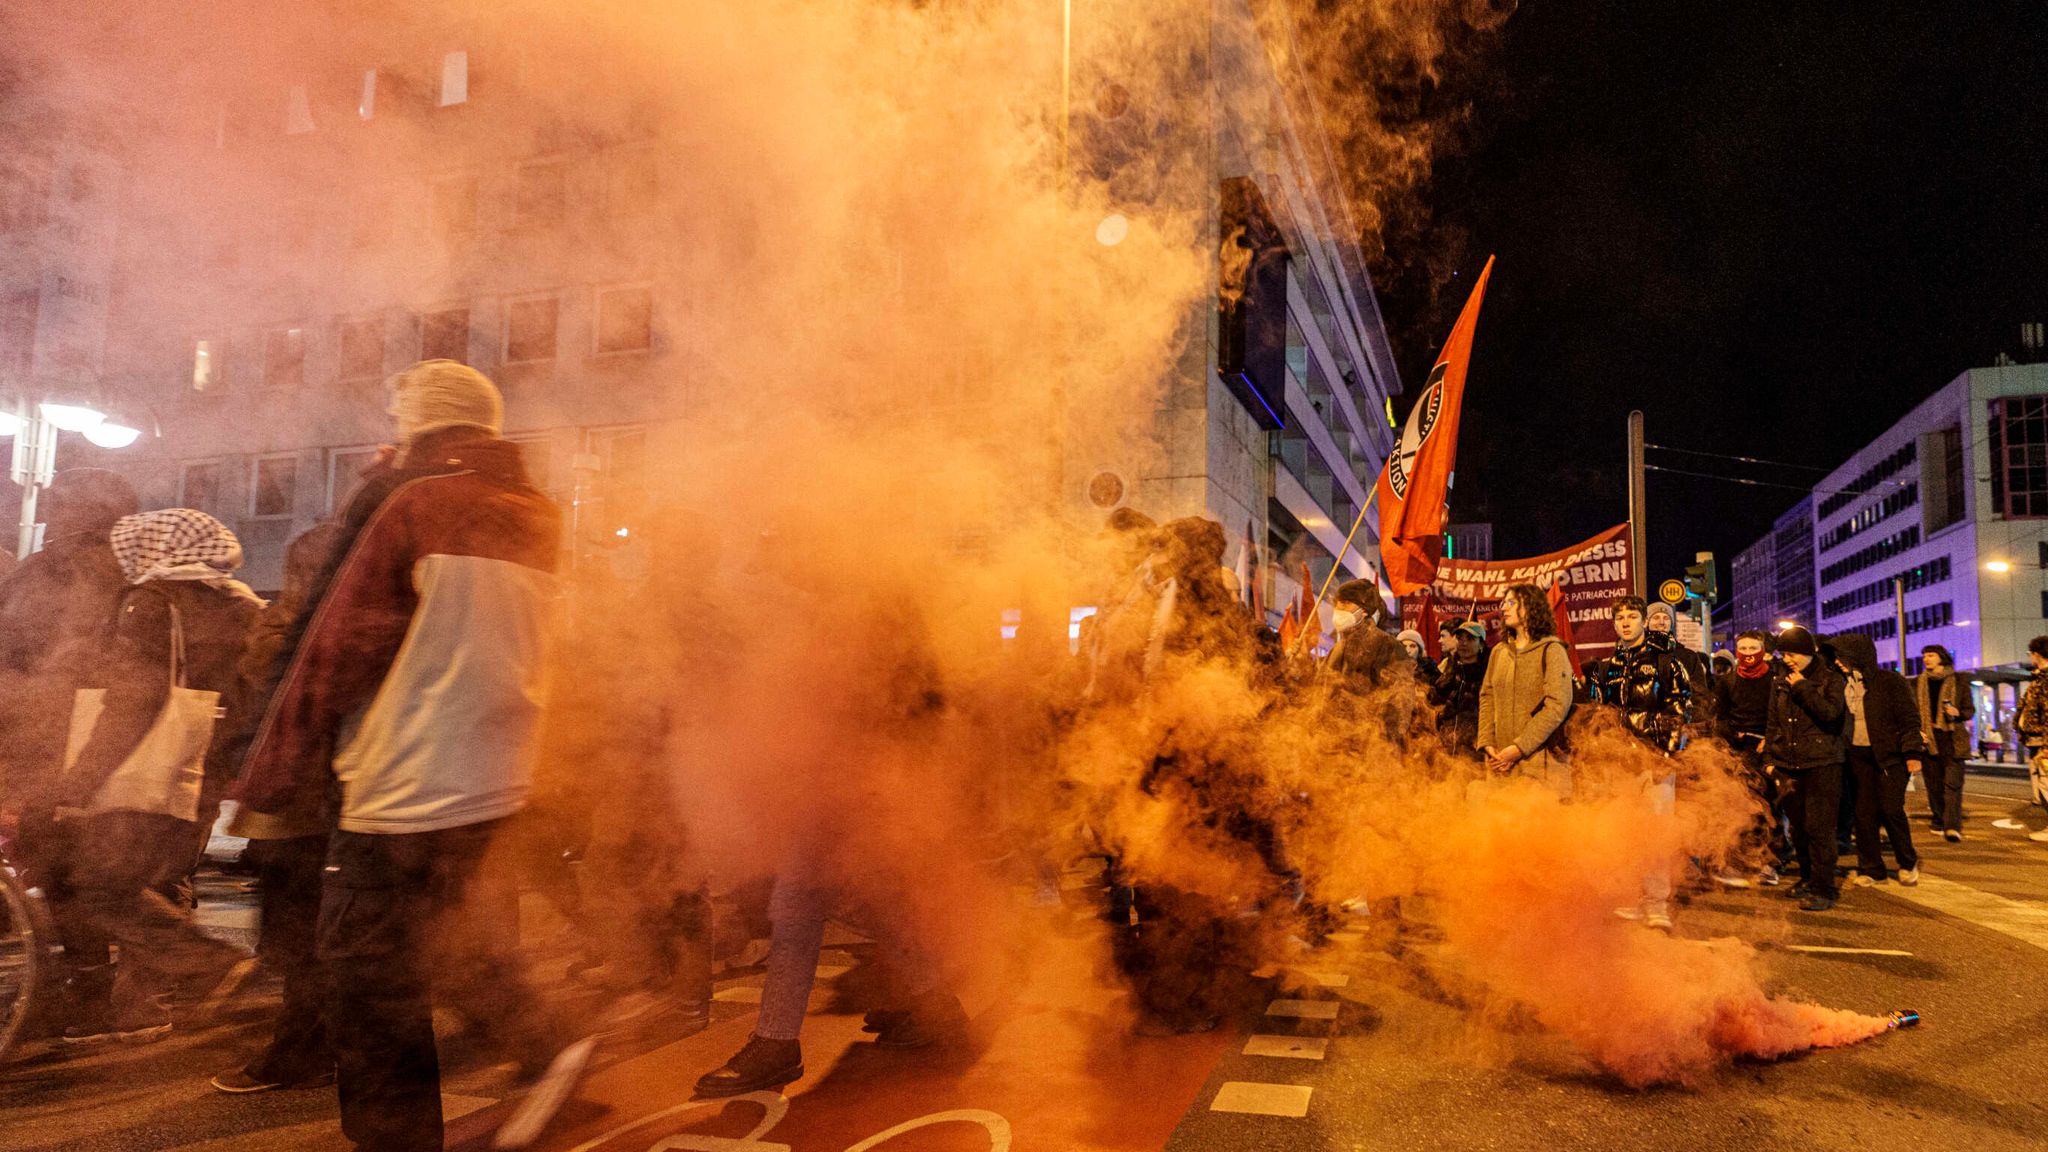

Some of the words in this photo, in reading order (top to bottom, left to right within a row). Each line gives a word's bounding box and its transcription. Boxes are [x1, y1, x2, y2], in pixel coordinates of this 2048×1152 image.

[1456, 568, 1507, 582] WAHL
[1511, 559, 1563, 579] KANN
[1564, 540, 1626, 566] DIESES
[1665, 587, 1680, 596] HH
